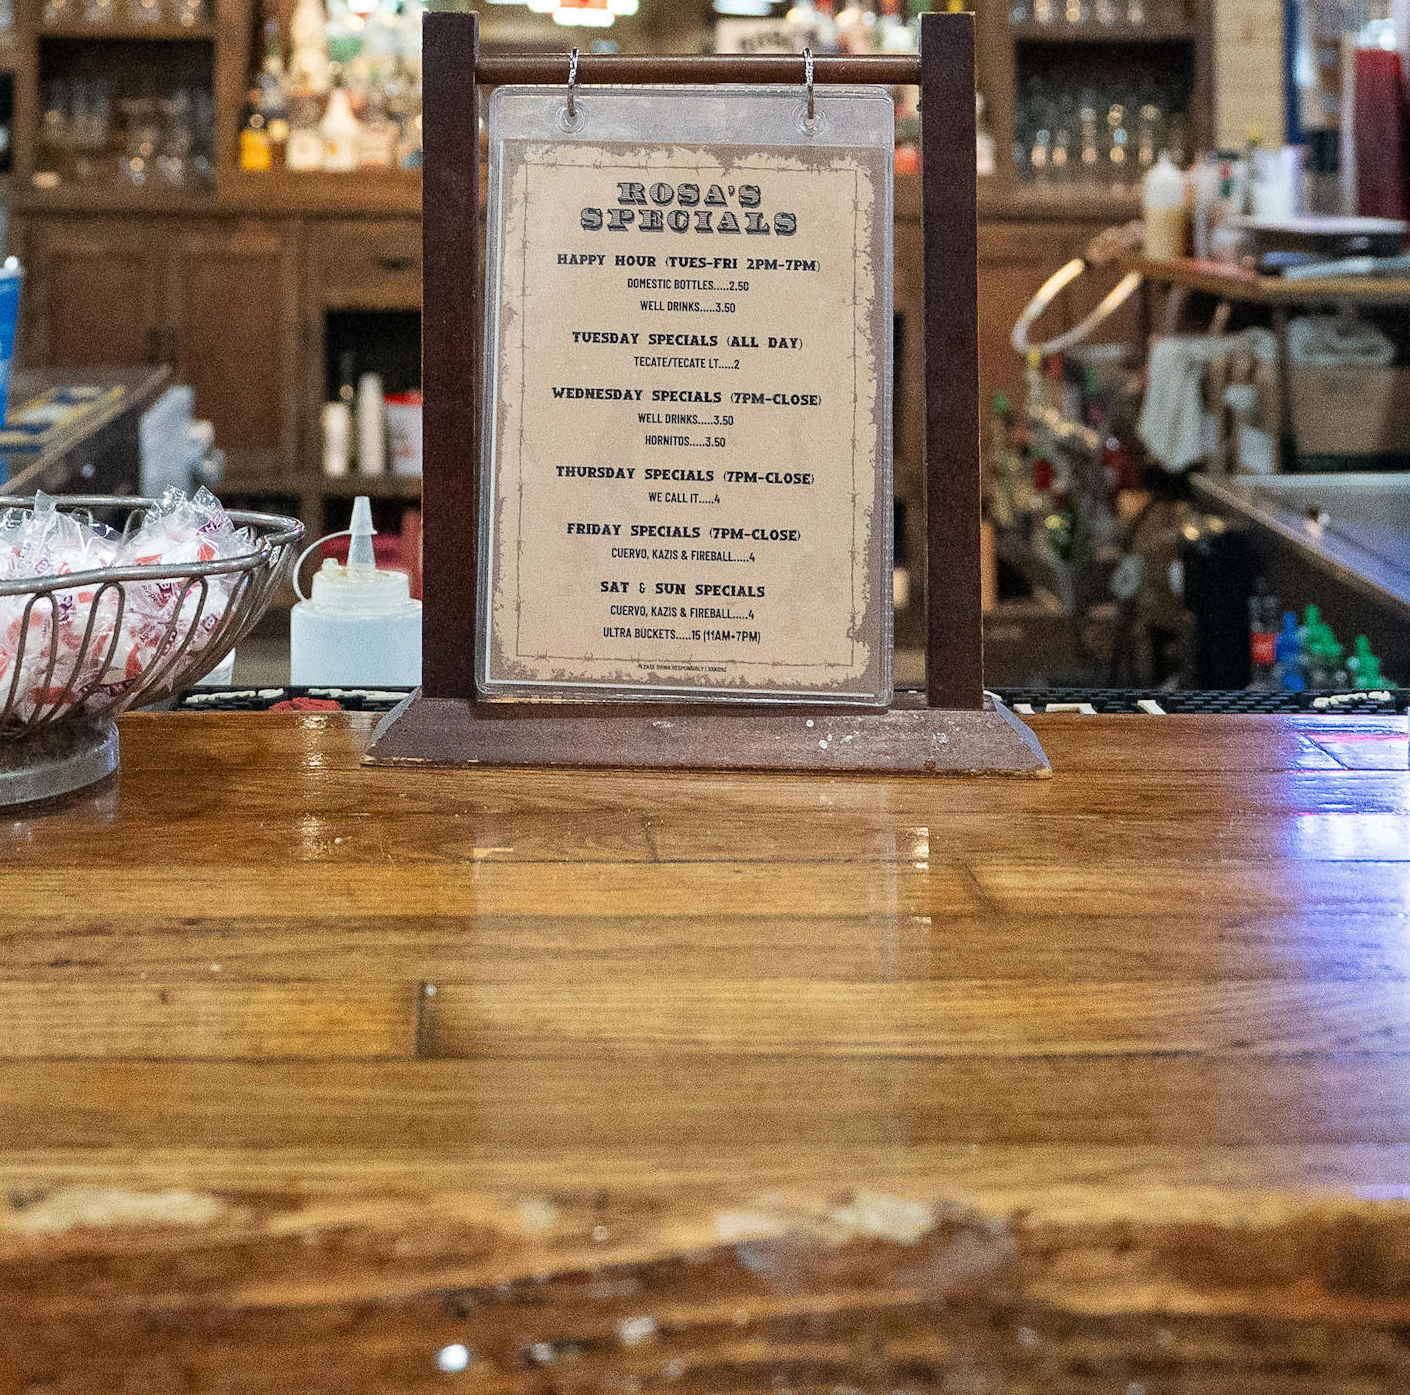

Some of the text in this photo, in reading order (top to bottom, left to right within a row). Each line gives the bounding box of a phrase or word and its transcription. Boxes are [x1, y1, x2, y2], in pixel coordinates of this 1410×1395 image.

[618, 182, 761, 207] ROSA'S
[580, 208, 797, 235] SPECIALS
[557, 254, 820, 272] HAPPY HOUR (TUES-FRI 2PM-7PM)
[628, 278, 672, 289] DOMESTIC
[640, 300, 665, 311] WELL
[572, 331, 803, 350] TUESDAY SPECIALS (ALL DAY)
[634, 356, 707, 368] TECATE/TECATE
[552, 387, 822, 406] WEDNESDAY SPECIALS (7PM-CLOSE)
[638, 413, 663, 424] WELL
[556, 465, 815, 484] THURSDAY SPECIALS (7PM-CLOSE)
[648, 491, 663, 502] WE
[665, 492, 688, 503] CALL
[567, 523, 801, 541] FRIDAY SPECIALS (7PM-CLOSE)
[611, 548, 650, 560] CUERVO,
[652, 549, 678, 560] KAZIS
[601, 581, 629, 593] SAT
[655, 582, 686, 595] SUN
[695, 583, 765, 597] SPECIALS
[610, 605, 649, 618] CUERVO,
[651, 606, 677, 618] KAZIS
[603, 627, 632, 638] ULTRA
[703, 629, 761, 643] (11AM-7PM)
